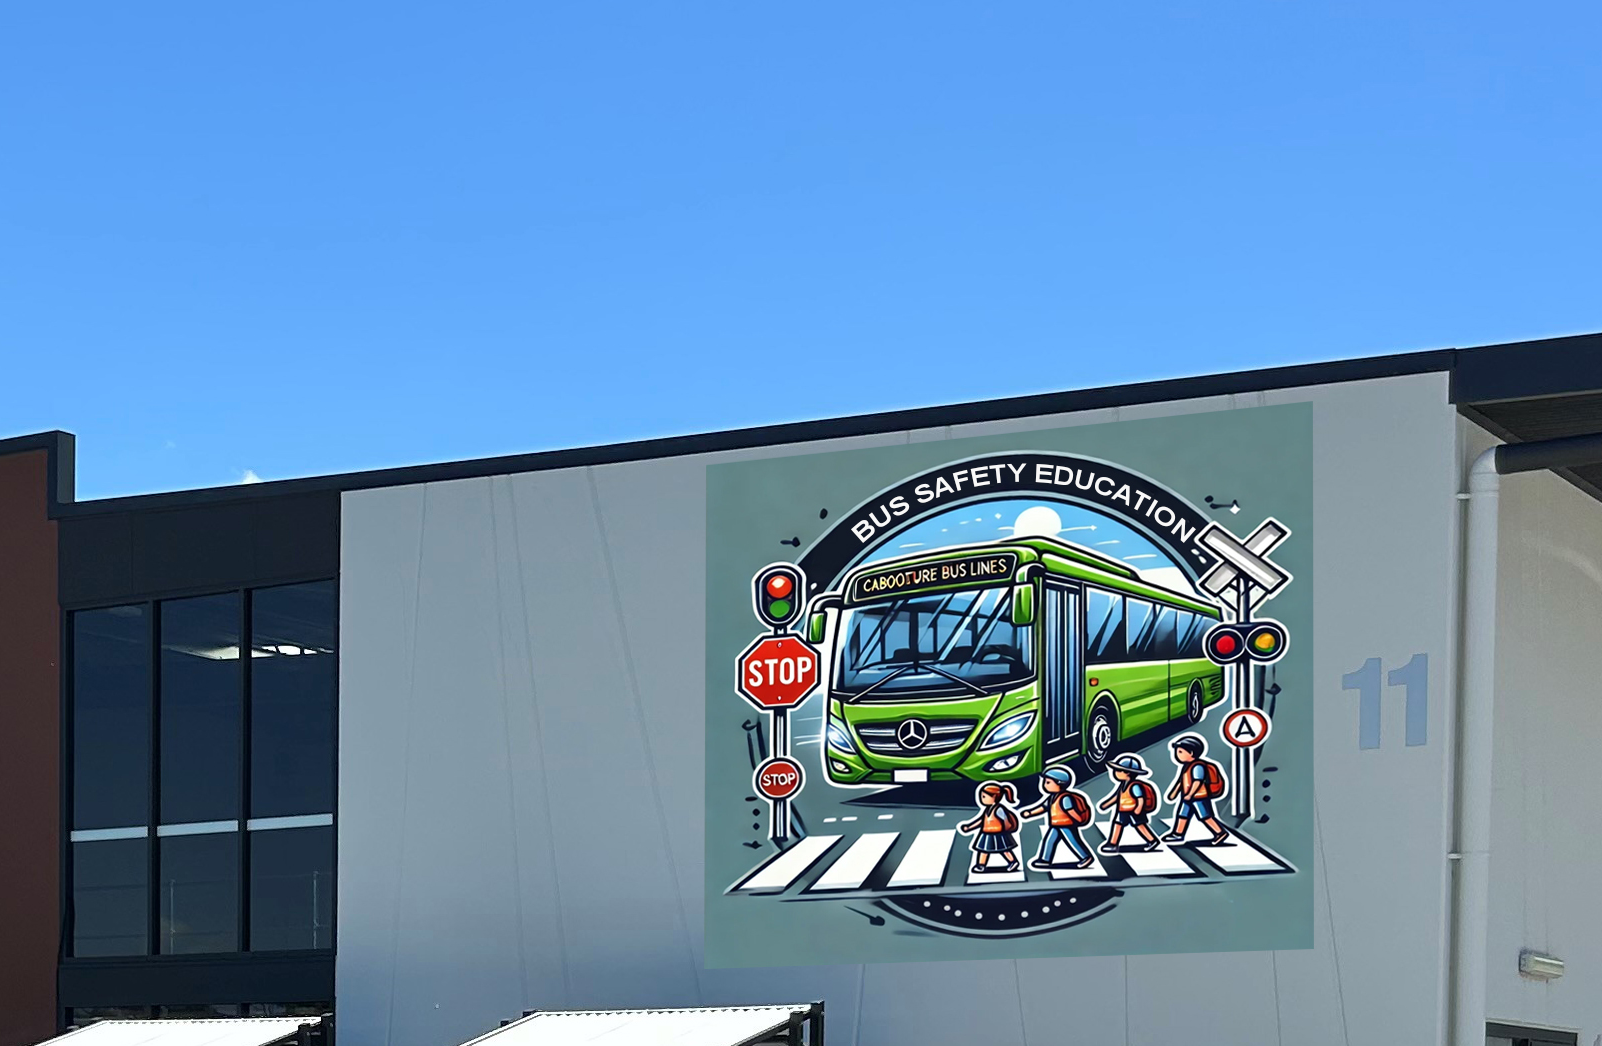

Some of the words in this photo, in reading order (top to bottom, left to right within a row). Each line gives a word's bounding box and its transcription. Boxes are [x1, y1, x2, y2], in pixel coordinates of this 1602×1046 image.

[851, 495, 910, 543] BUS
[914, 463, 1027, 503] SAFETY
[1035, 463, 1196, 543] EDUCATION
[941, 563, 967, 580] BUS
[970, 558, 1007, 577] LINES
[748, 656, 813, 687] STOP
[1342, 653, 1428, 750] 11
[1235, 715, 1256, 738] A
[762, 772, 796, 787] STOP
